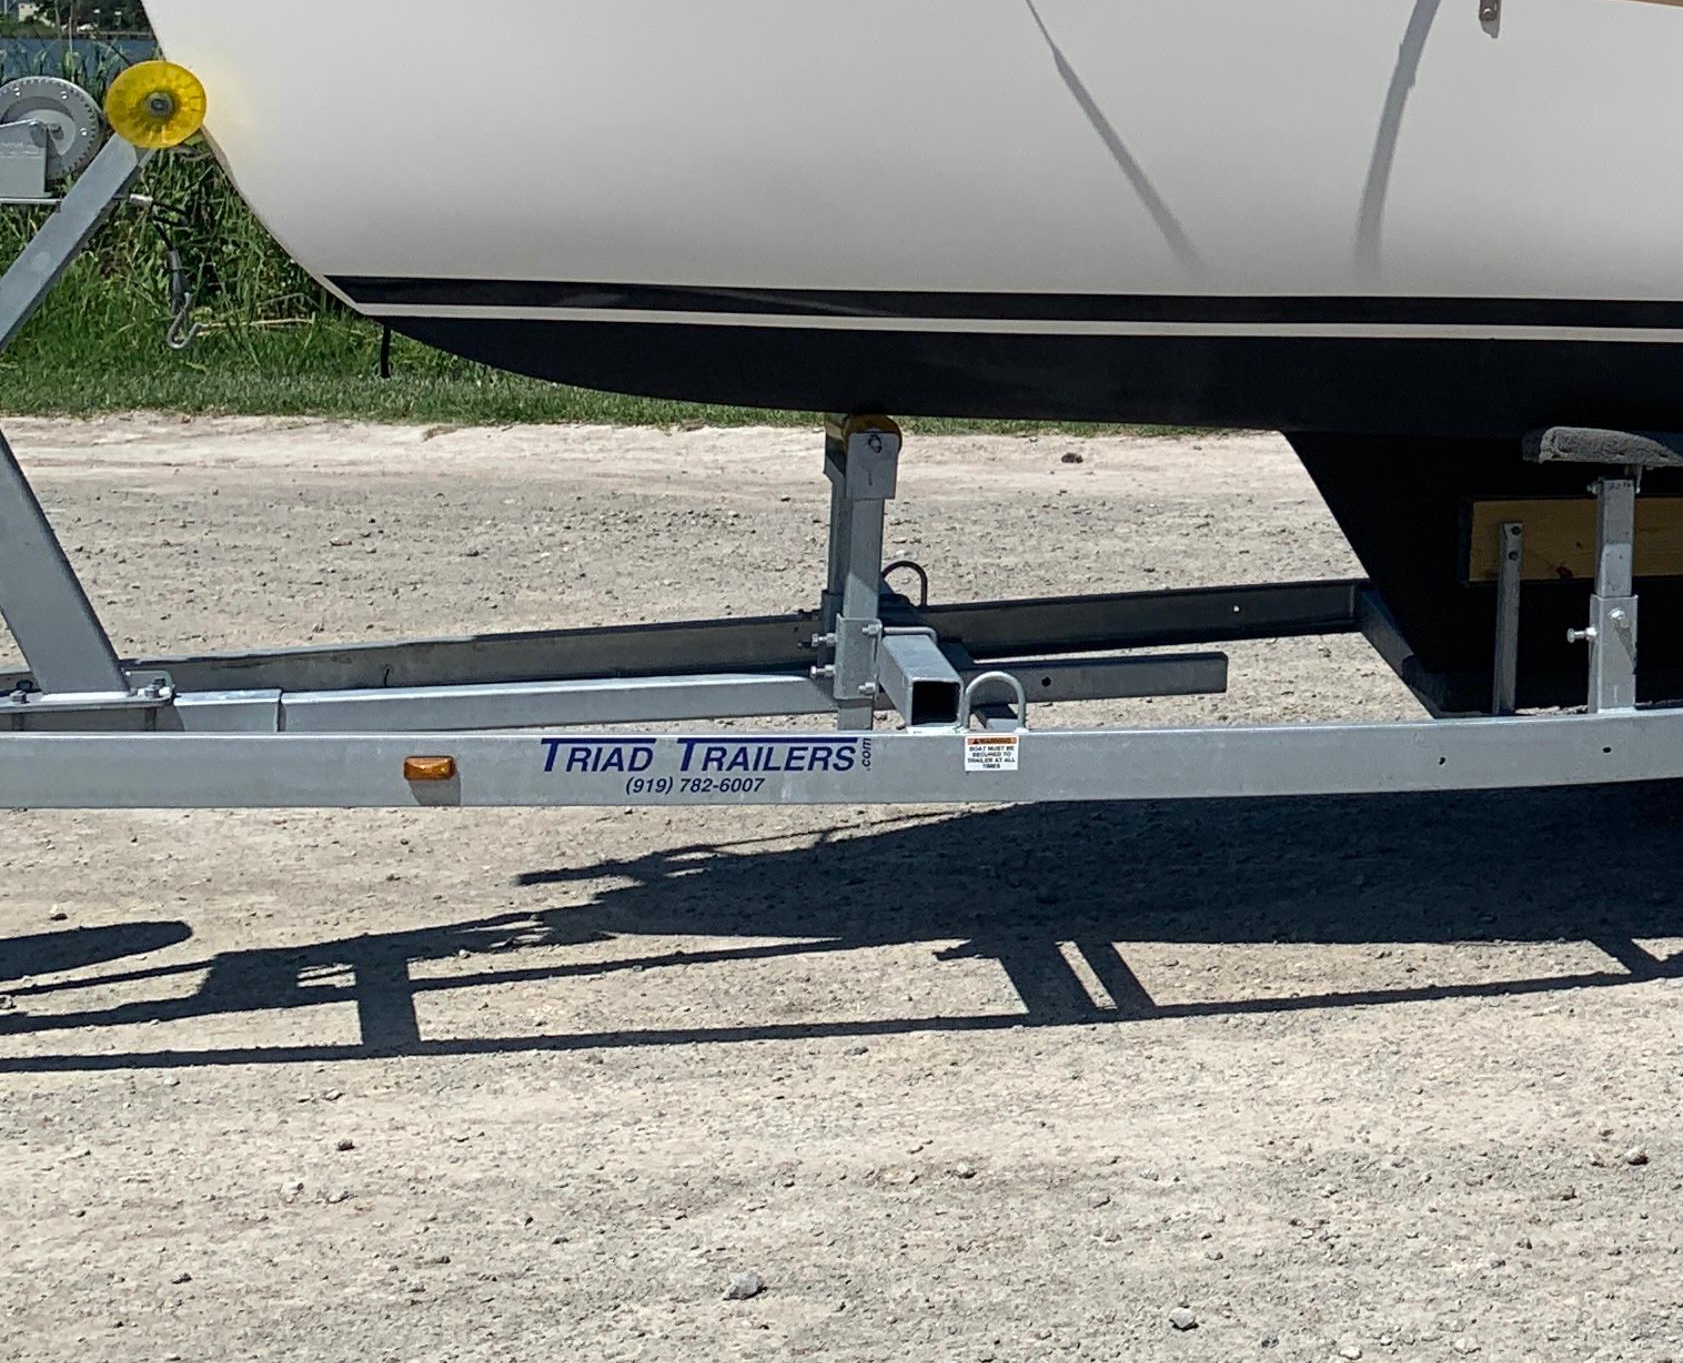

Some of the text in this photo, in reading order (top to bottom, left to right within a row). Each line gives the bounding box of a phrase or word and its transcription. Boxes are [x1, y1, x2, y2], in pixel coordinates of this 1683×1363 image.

[540, 737, 858, 773] TRIAD TRAILERS
[626, 776, 766, 795] (919) 782-6007
